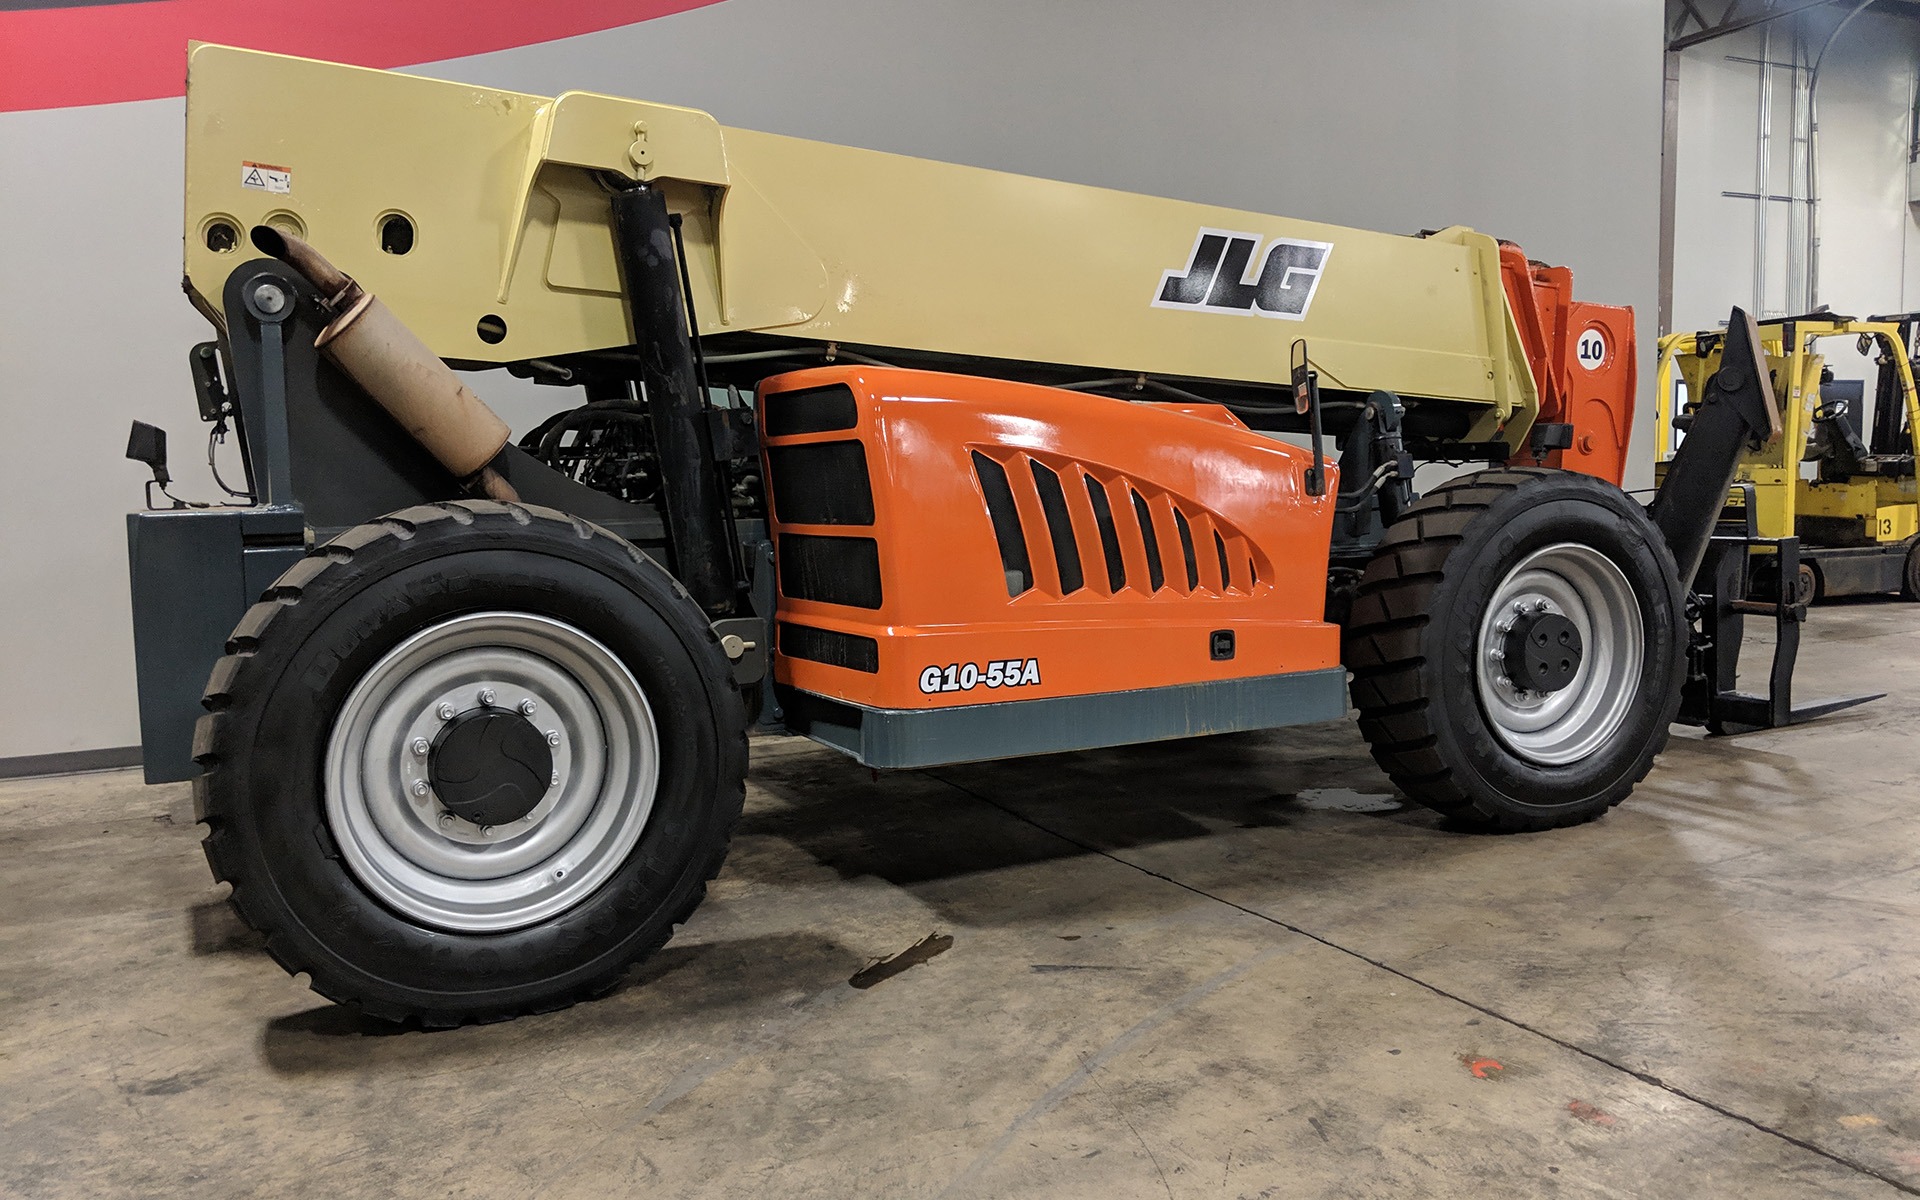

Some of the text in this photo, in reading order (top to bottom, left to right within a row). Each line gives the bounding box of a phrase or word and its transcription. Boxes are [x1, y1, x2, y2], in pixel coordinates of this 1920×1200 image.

[1156, 231, 1329, 317] JLG
[1580, 338, 1603, 361] 10
[1879, 518, 1892, 536] 13
[919, 658, 1041, 694] G10-55A
